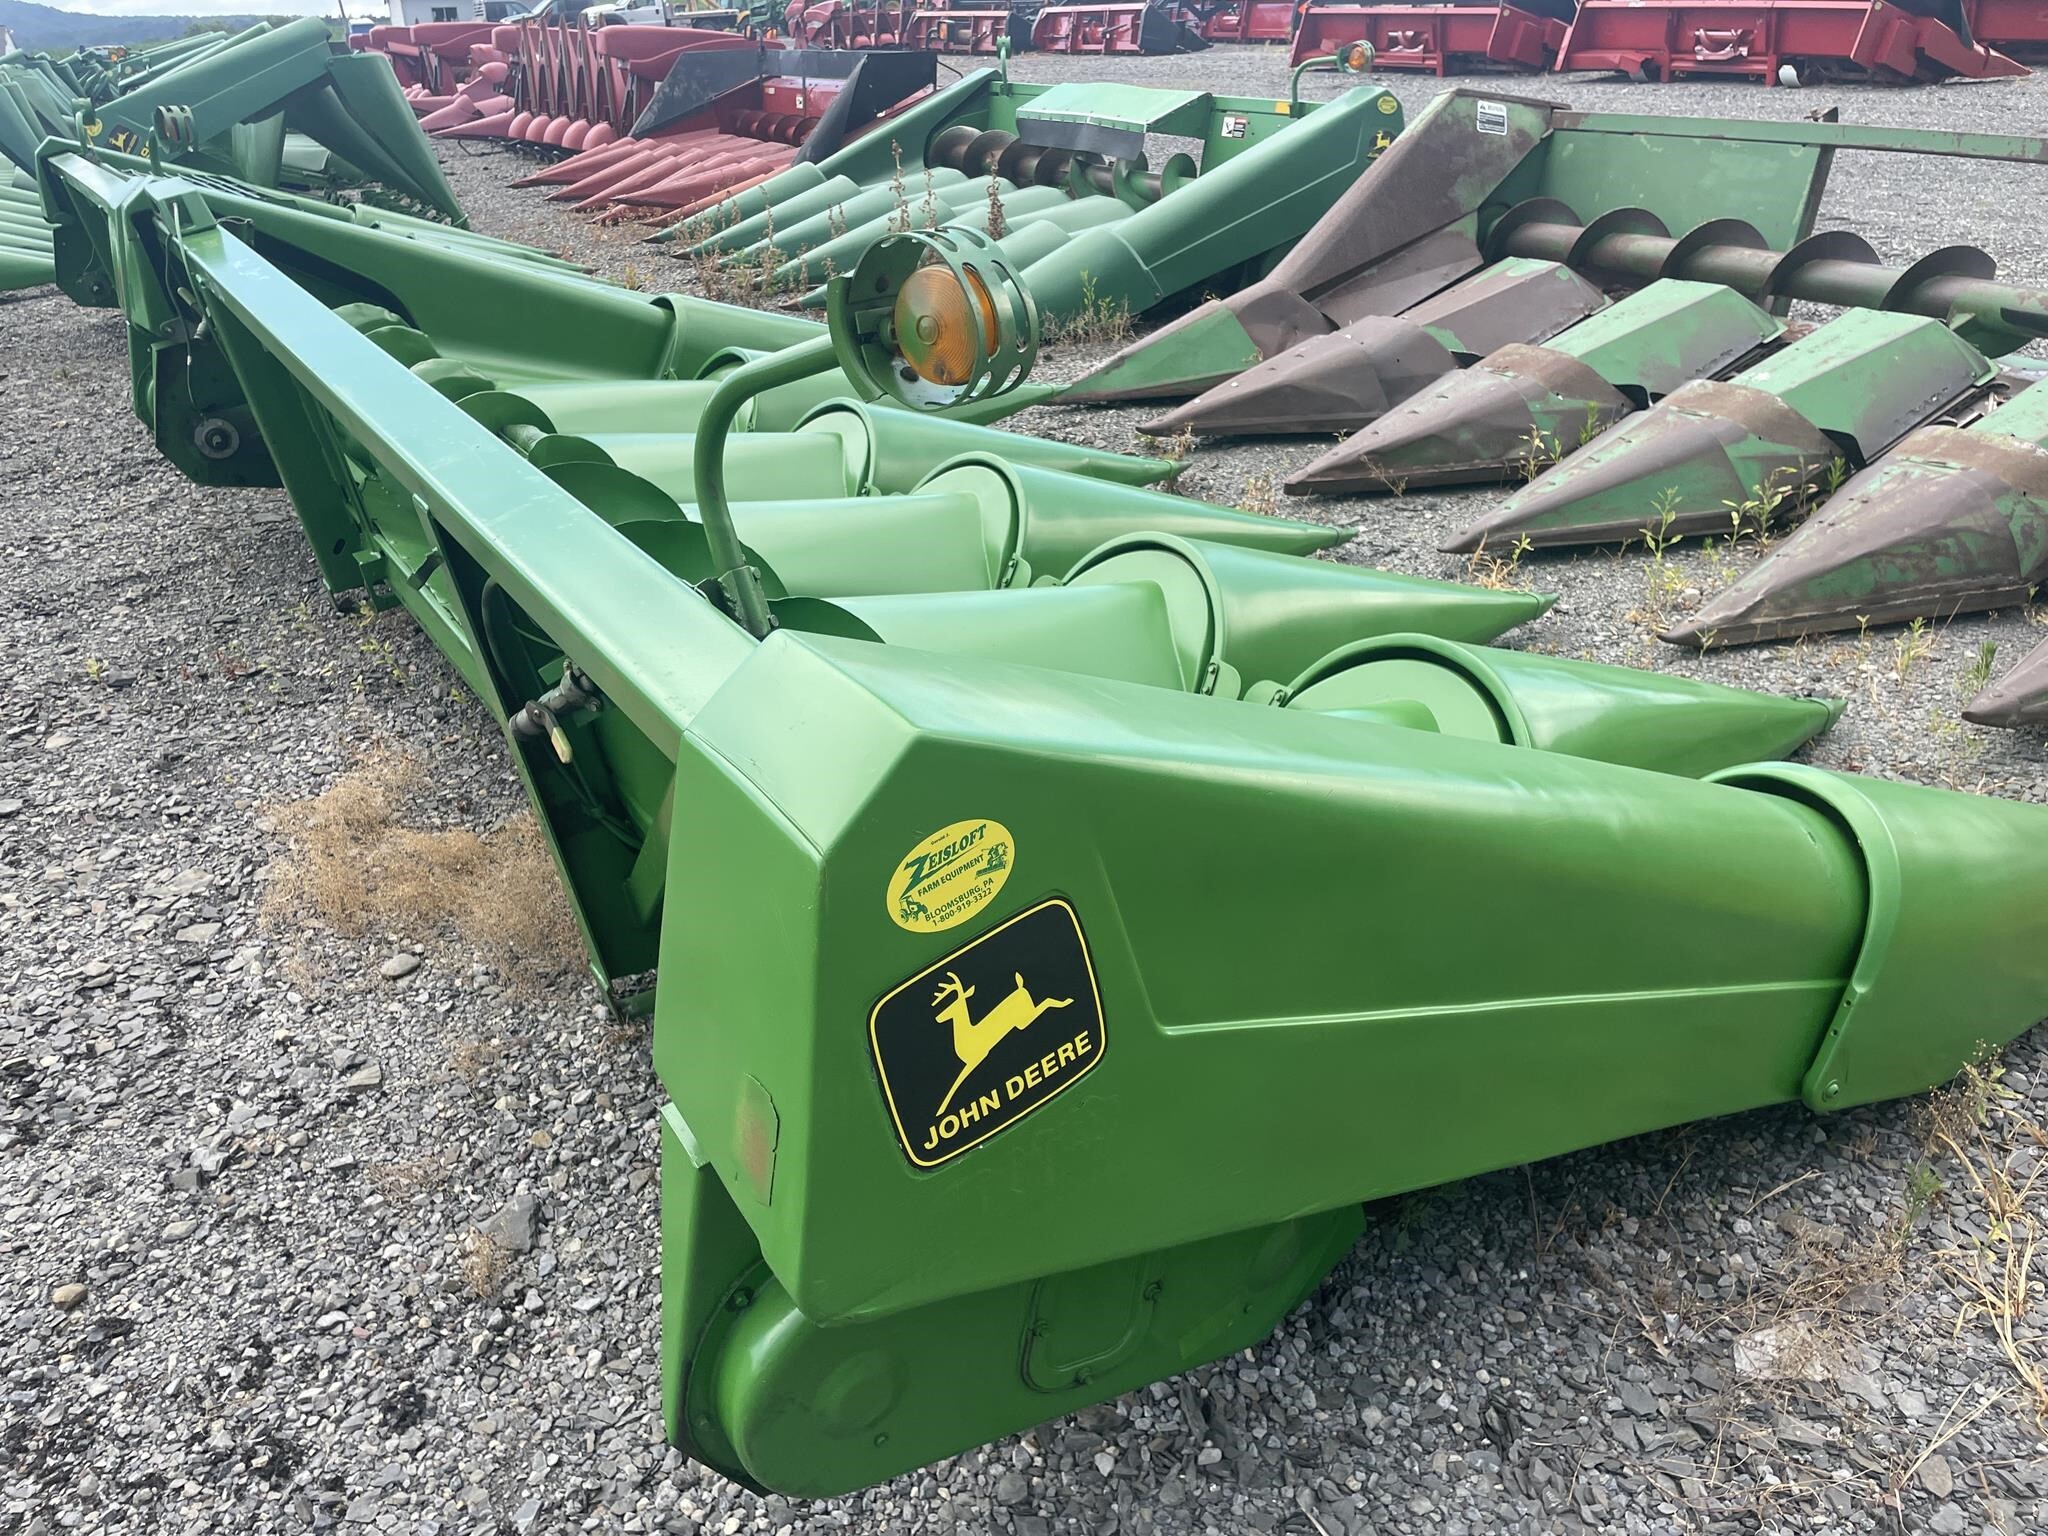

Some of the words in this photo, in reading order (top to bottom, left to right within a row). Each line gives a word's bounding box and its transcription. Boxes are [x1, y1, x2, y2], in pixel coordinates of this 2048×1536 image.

[900, 824, 987, 900] ZEISLOFT
[917, 880, 941, 897] FARM
[941, 854, 984, 884] EQUIPMENT
[924, 884, 983, 921] BLOOMSBURG,
[983, 877, 994, 888] PA
[932, 887, 993, 927] 1-800-919-3322
[924, 1088, 1001, 1150] JOHN
[1005, 1030, 1092, 1101] DEERE
